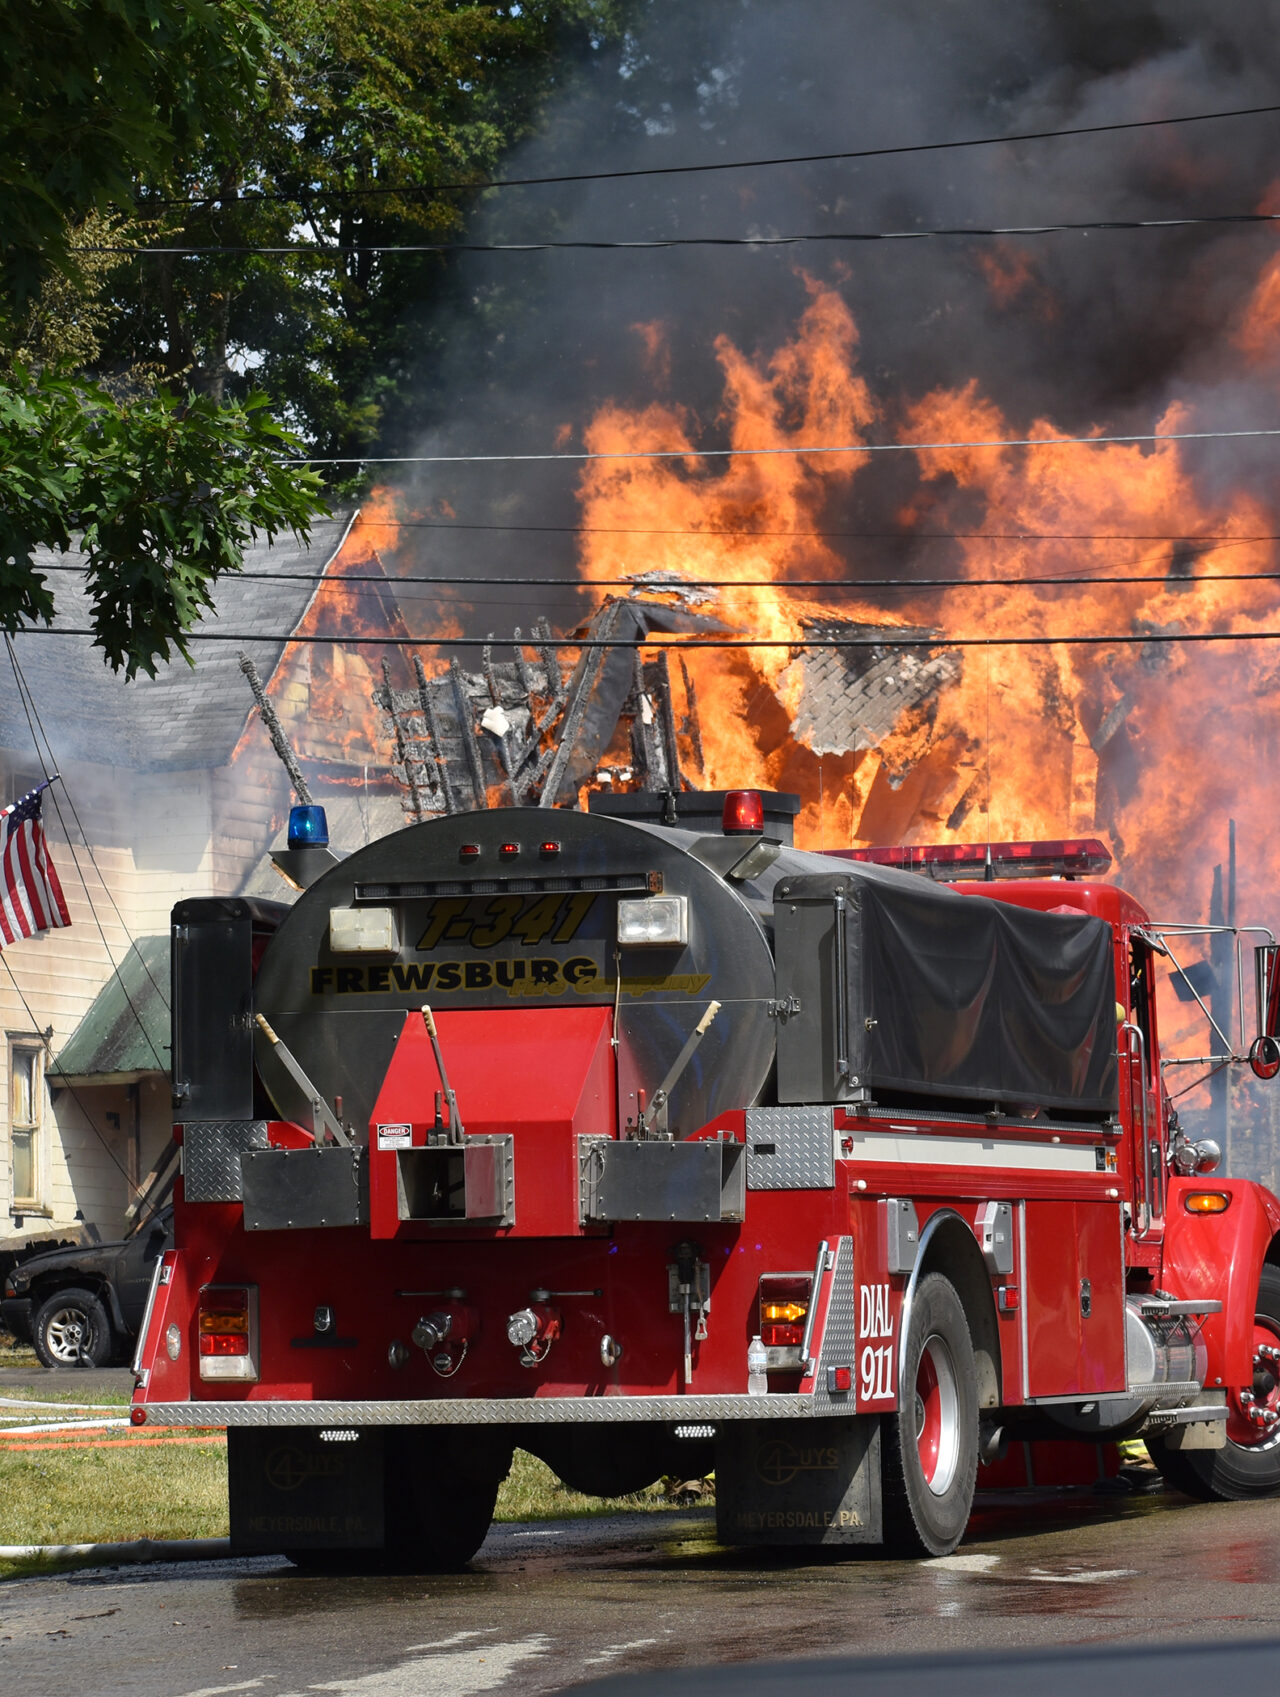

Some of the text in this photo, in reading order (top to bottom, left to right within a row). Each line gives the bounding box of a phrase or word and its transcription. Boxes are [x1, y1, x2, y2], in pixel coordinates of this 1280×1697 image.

[416, 893, 597, 951] T-341
[310, 957, 597, 995] FREWSBURG
[383, 1127, 405, 1136] DANGER
[860, 1284, 894, 1338] DIAL
[861, 1345, 895, 1401] 911
[839, 1510, 865, 1527] PA.
